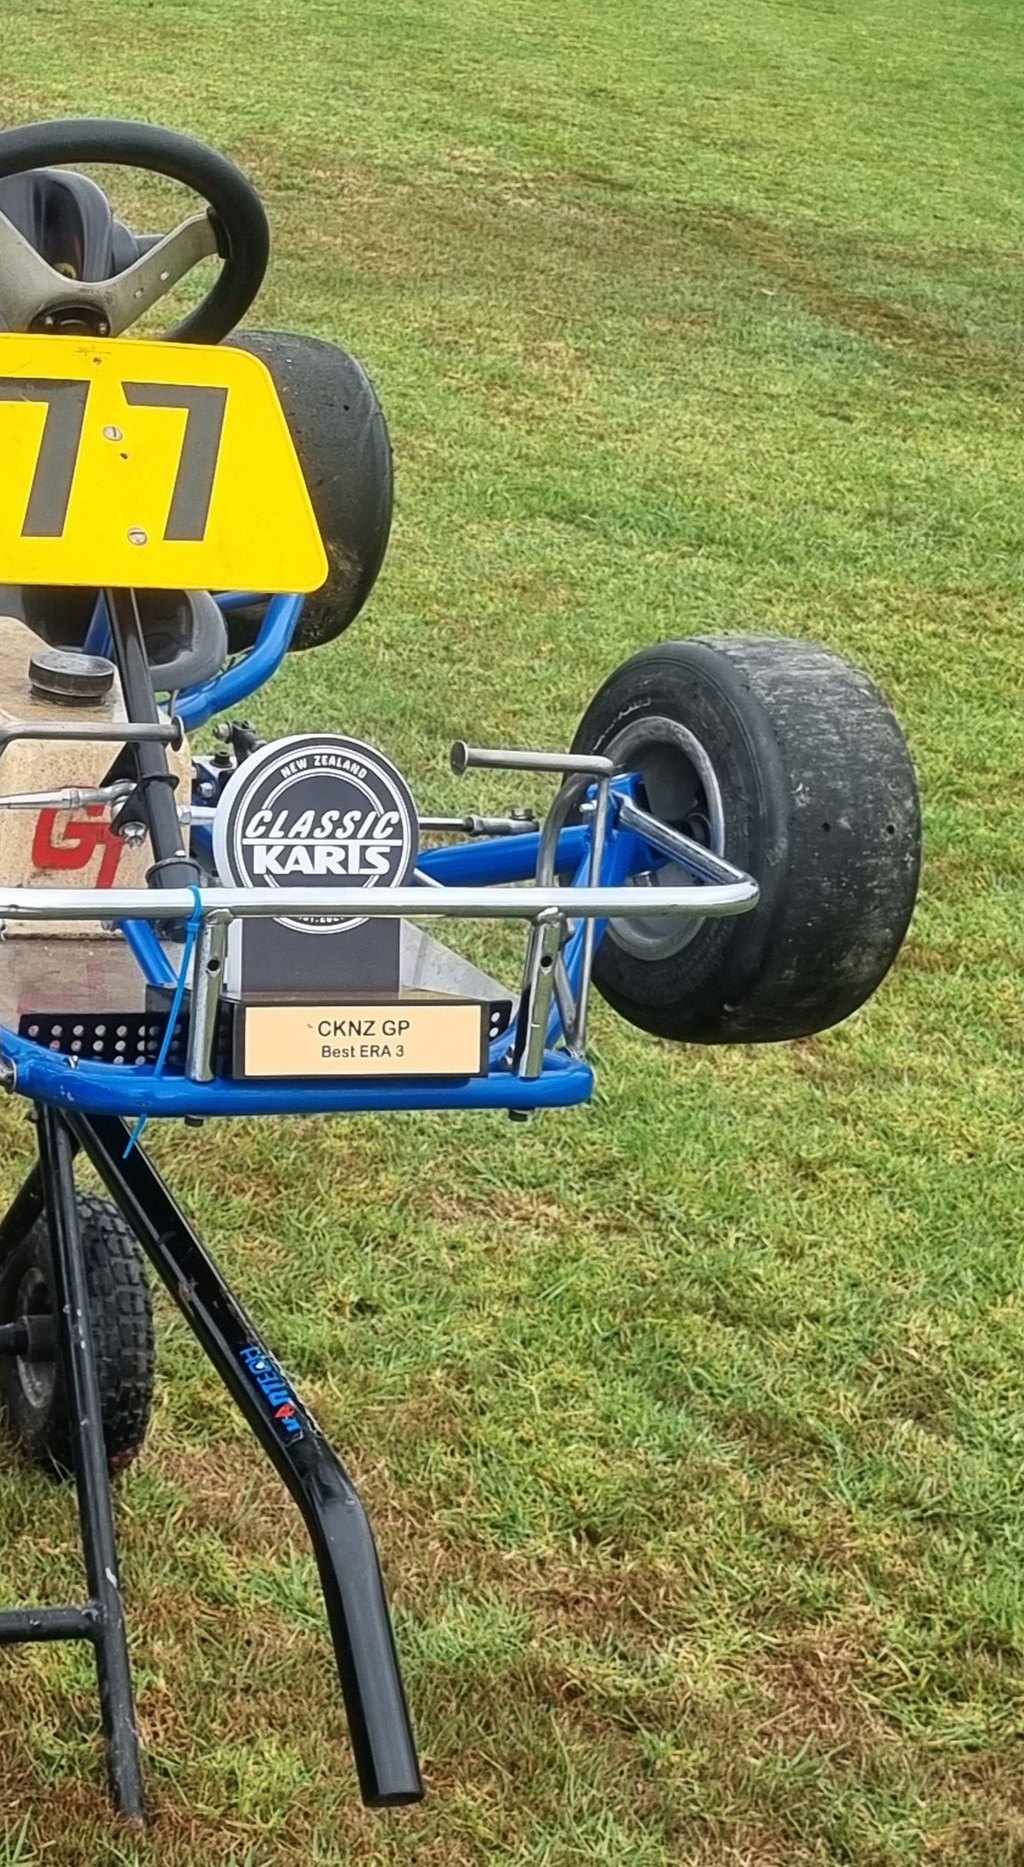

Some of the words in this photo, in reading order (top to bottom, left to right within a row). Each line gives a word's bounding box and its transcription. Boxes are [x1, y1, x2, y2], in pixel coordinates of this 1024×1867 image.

[280, 757, 308, 779] NEW
[313, 754, 368, 779] ZEALAND
[244, 809, 401, 840] CLASSIC
[252, 844, 391, 876] KARTS
[317, 1020, 376, 1037] CKNZ
[382, 1019, 411, 1036] GP
[321, 1045, 356, 1058] Best
[360, 1045, 392, 1058] ERA
[395, 1044, 405, 1057] 3
